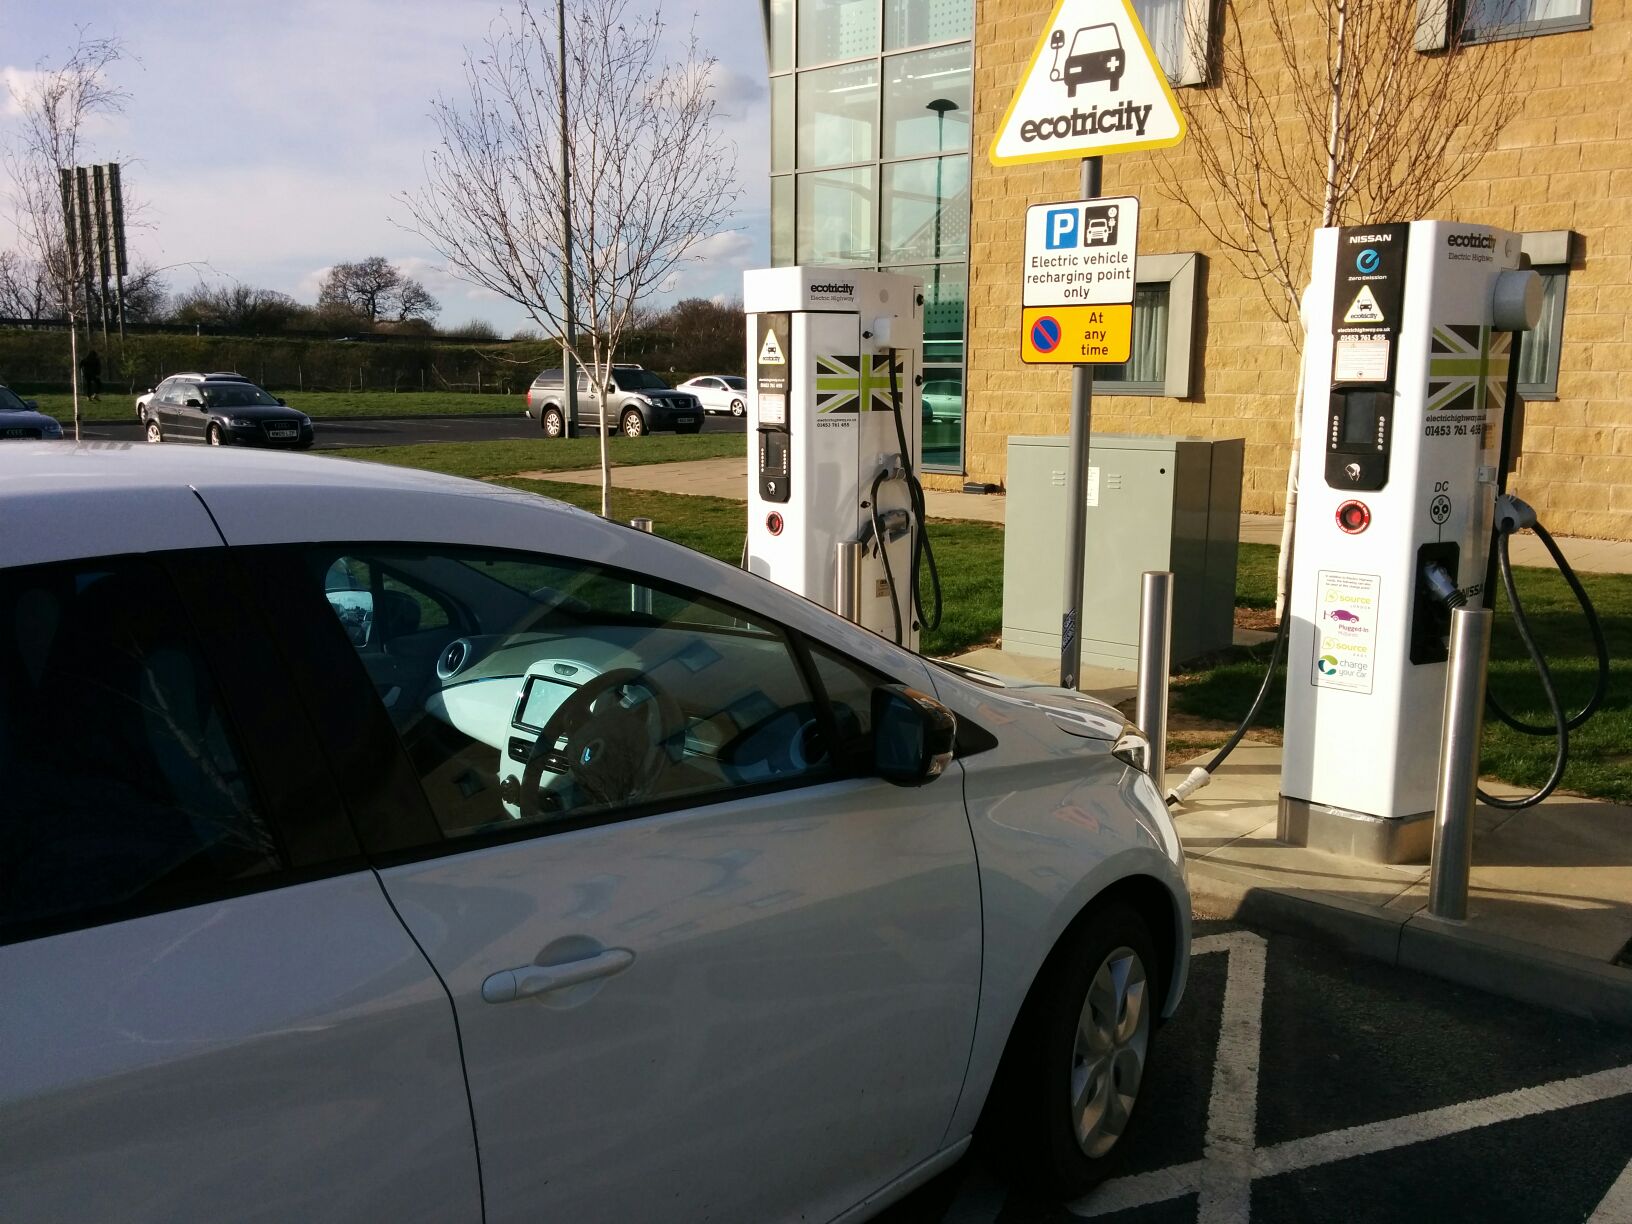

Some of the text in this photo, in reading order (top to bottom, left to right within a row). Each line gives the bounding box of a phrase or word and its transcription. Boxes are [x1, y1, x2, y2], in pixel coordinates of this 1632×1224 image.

[1020, 100, 1152, 142] ecotricity
[1052, 213, 1075, 246] P
[1349, 233, 1392, 244] NISSAN
[1031, 251, 1128, 268] Electric vehicle
[1027, 267, 1131, 284] recharging point
[810, 283, 854, 295] ecotricity
[1064, 286, 1090, 300] only
[1089, 311, 1104, 324] At
[1084, 330, 1107, 342] any
[1081, 344, 1109, 356] time
[1425, 425, 1451, 436] 01453
[1453, 425, 1467, 435] 761
[1434, 480, 1449, 493] DC
[1339, 659, 1368, 672] charge
